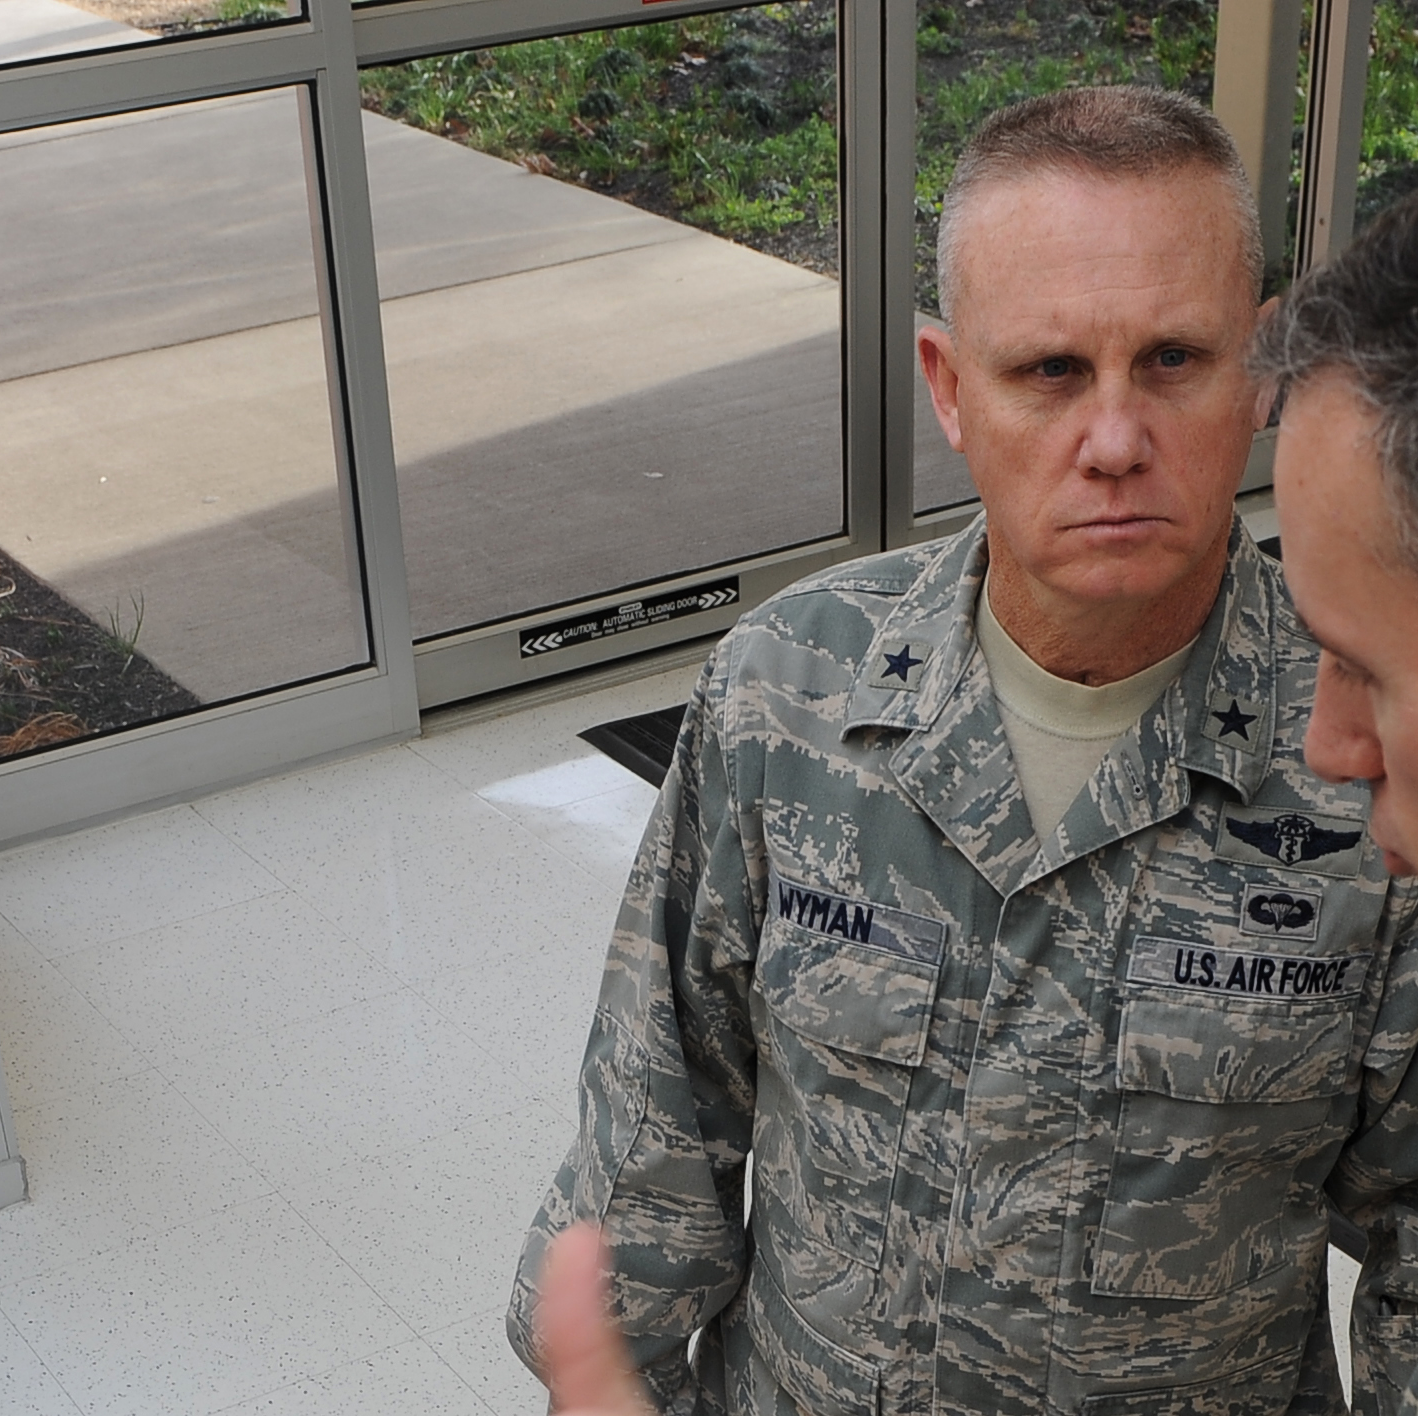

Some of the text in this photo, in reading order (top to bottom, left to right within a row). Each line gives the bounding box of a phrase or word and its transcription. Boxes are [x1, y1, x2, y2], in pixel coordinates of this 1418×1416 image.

[562, 621, 598, 641] CAUTION:
[602, 609, 646, 629] AUTOMATIC
[647, 602, 676, 617] SLIDING
[677, 595, 698, 610] DOOR
[779, 881, 875, 943] WYMAN
[1174, 948, 1351, 994] U.S. AIR FORCE
